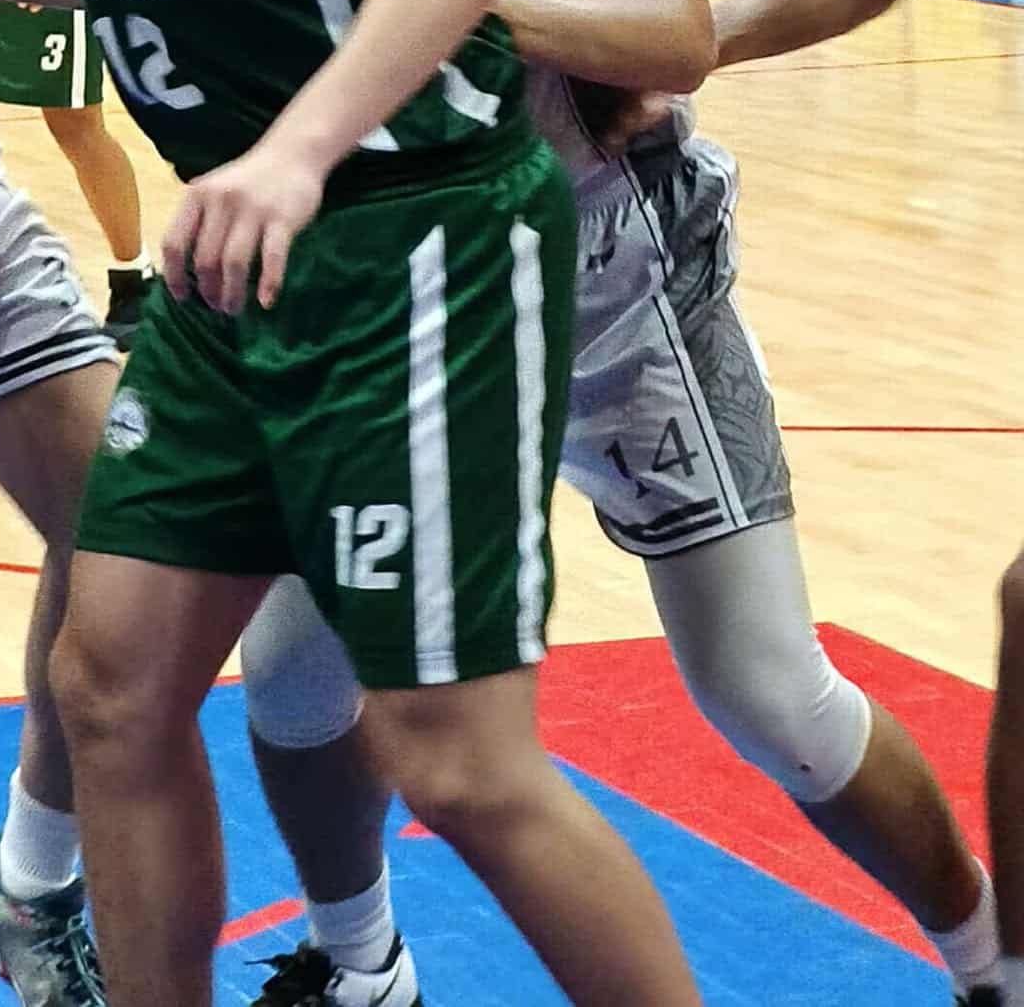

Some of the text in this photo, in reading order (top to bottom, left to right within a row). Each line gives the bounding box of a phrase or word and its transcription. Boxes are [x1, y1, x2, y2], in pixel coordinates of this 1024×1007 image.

[40, 34, 67, 71] 3
[92, 15, 205, 110] 12
[604, 416, 699, 498] 14
[329, 503, 413, 590] 12
